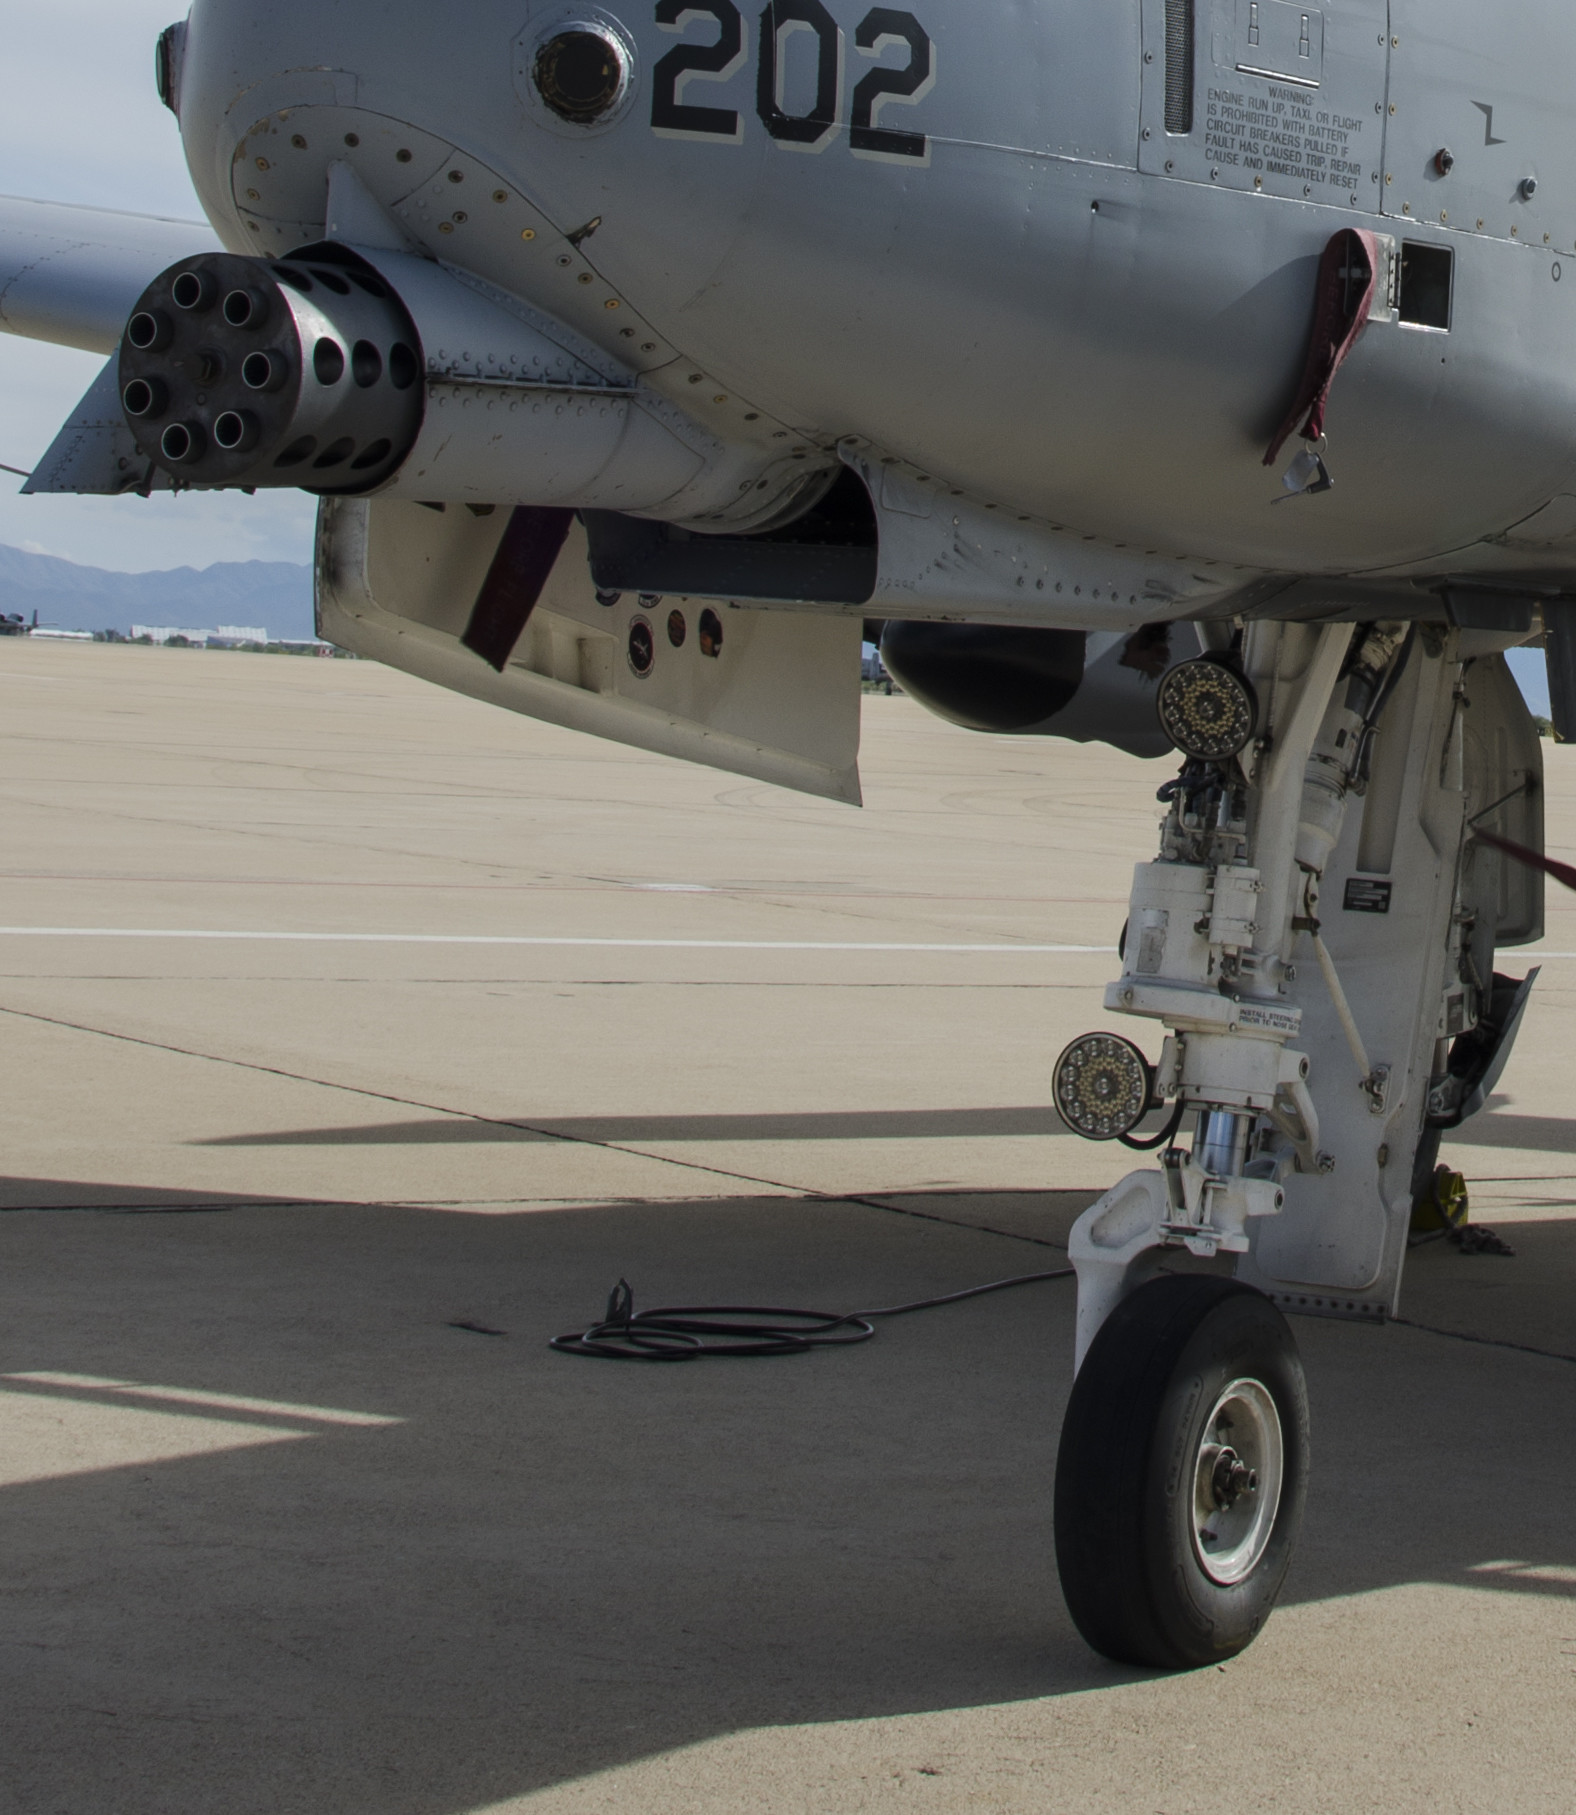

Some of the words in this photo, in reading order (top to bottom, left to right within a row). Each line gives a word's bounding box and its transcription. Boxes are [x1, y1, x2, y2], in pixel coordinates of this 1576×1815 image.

[1207, 88, 1244, 106] ENGINE
[1249, 96, 1269, 111] RUN
[1272, 102, 1287, 116] UP,
[1316, 111, 1329, 124] OR
[1332, 114, 1363, 132] FLIGHT
[1268, 86, 1315, 106] WARNING:
[1206, 118, 1246, 137] CIRCUIT
[1250, 126, 1301, 148] BREAKERS
[1304, 138, 1338, 156] PULLED
[1341, 146, 1349, 158] IF
[1207, 103, 1217, 115] IS
[1221, 105, 1278, 128] PROHIBITED
[1282, 118, 1305, 133] WITH
[1308, 124, 1349, 144] BATTERY
[1205, 133, 1236, 150] FAULT
[1239, 140, 1259, 155] HAS
[1263, 144, 1302, 163] CAUSED
[1330, 158, 1361, 176] REPAIR
[1205, 147, 1239, 166] CAUSE
[1243, 156, 1263, 170] AND
[1266, 160, 1327, 185] IMMEDIATELY
[1329, 173, 1359, 190] RESET
[1262, 1019, 1272, 1027] TO
